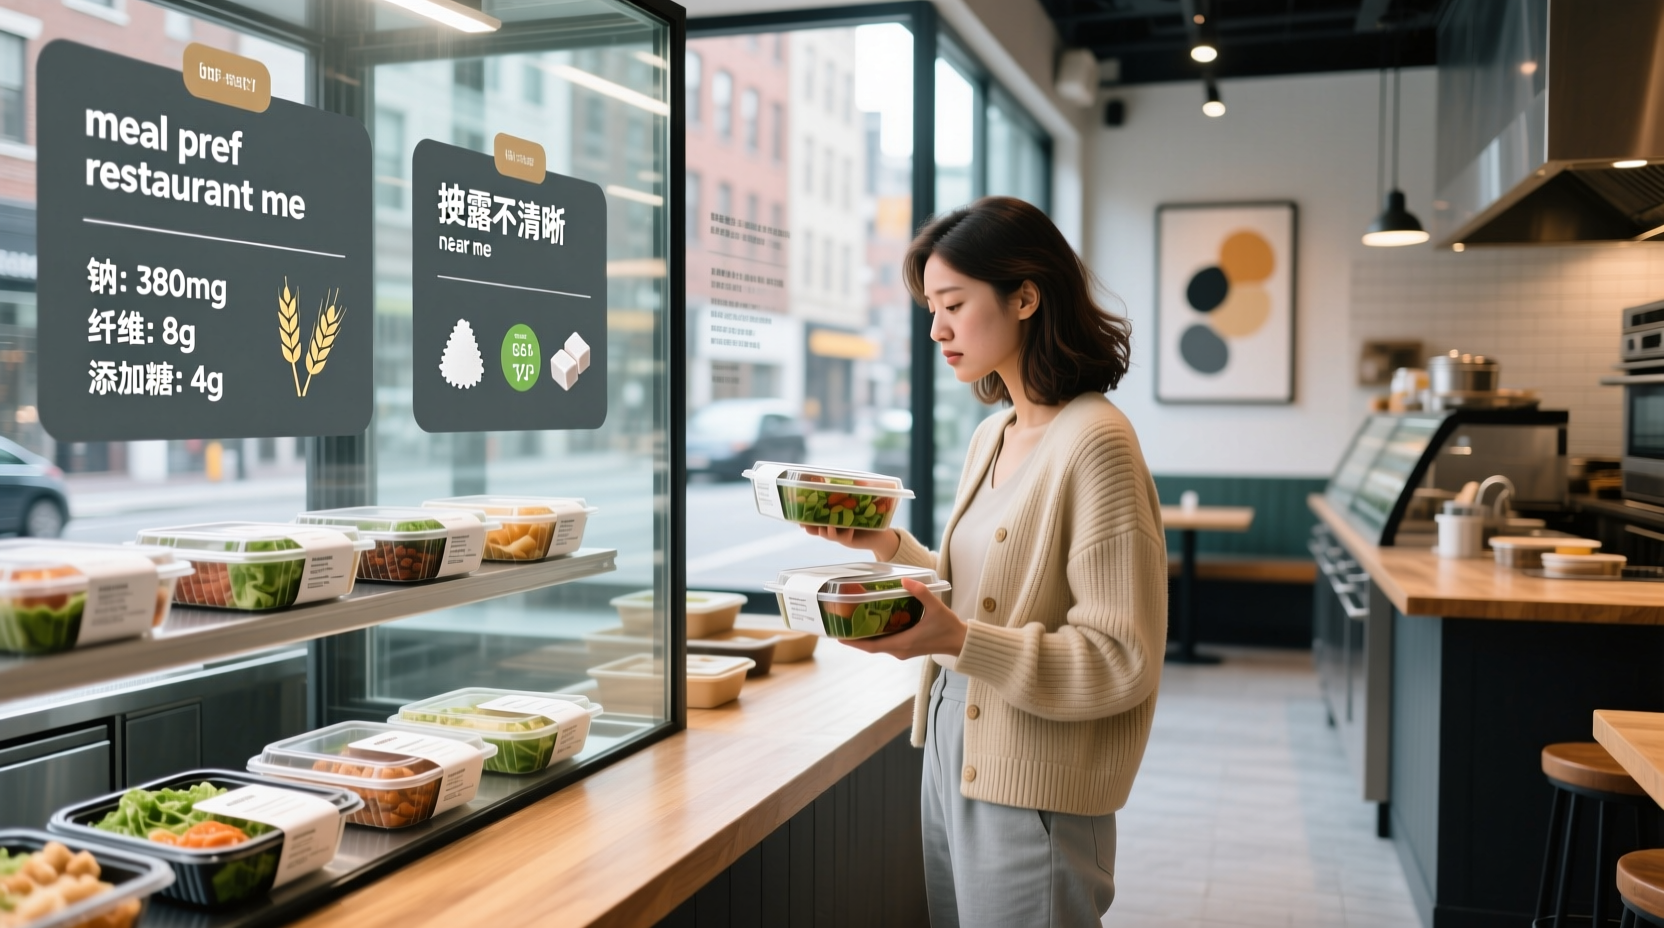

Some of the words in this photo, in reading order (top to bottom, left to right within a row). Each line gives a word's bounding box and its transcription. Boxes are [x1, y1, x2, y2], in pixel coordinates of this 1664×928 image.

[85, 108, 168, 152] meal
[178, 128, 243, 166] pref
[85, 157, 254, 212] restaurant
[261, 189, 306, 220] me
[438, 235, 470, 254] near
[472, 240, 492, 258] me
[135, 264, 227, 310] 380mg
[162, 315, 196, 354] 8g
[190, 364, 224, 402] 4g
